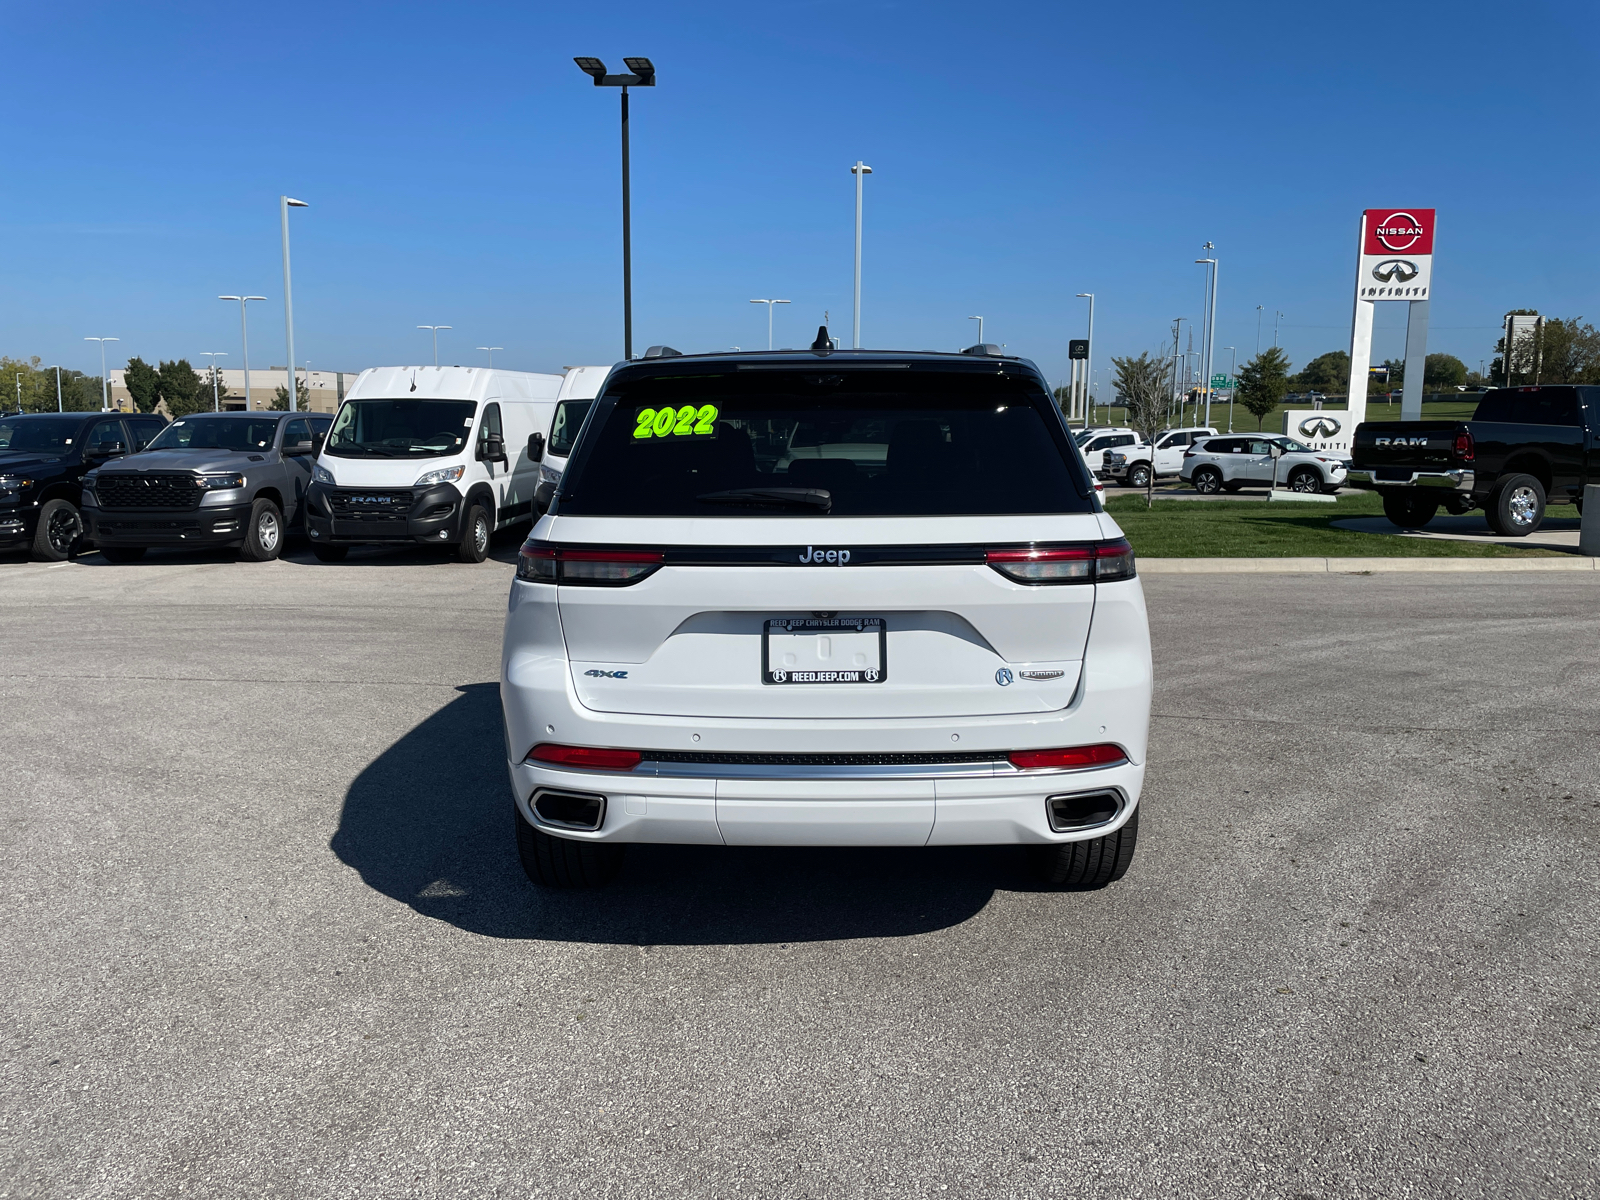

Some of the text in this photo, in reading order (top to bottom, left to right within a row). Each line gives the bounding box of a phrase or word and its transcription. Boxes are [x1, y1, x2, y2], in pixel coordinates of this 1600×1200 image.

[1376, 227, 1423, 235] NISSAN
[1361, 287, 1427, 297] INFINITI
[633, 404, 718, 439] 2022
[1375, 437, 1428, 446] RAM
[798, 545, 851, 567] Jeep
[770, 618, 880, 627] REED JEEP CHRYSLER DODGE RAM
[792, 671, 859, 682] REEDJEEP.COM
